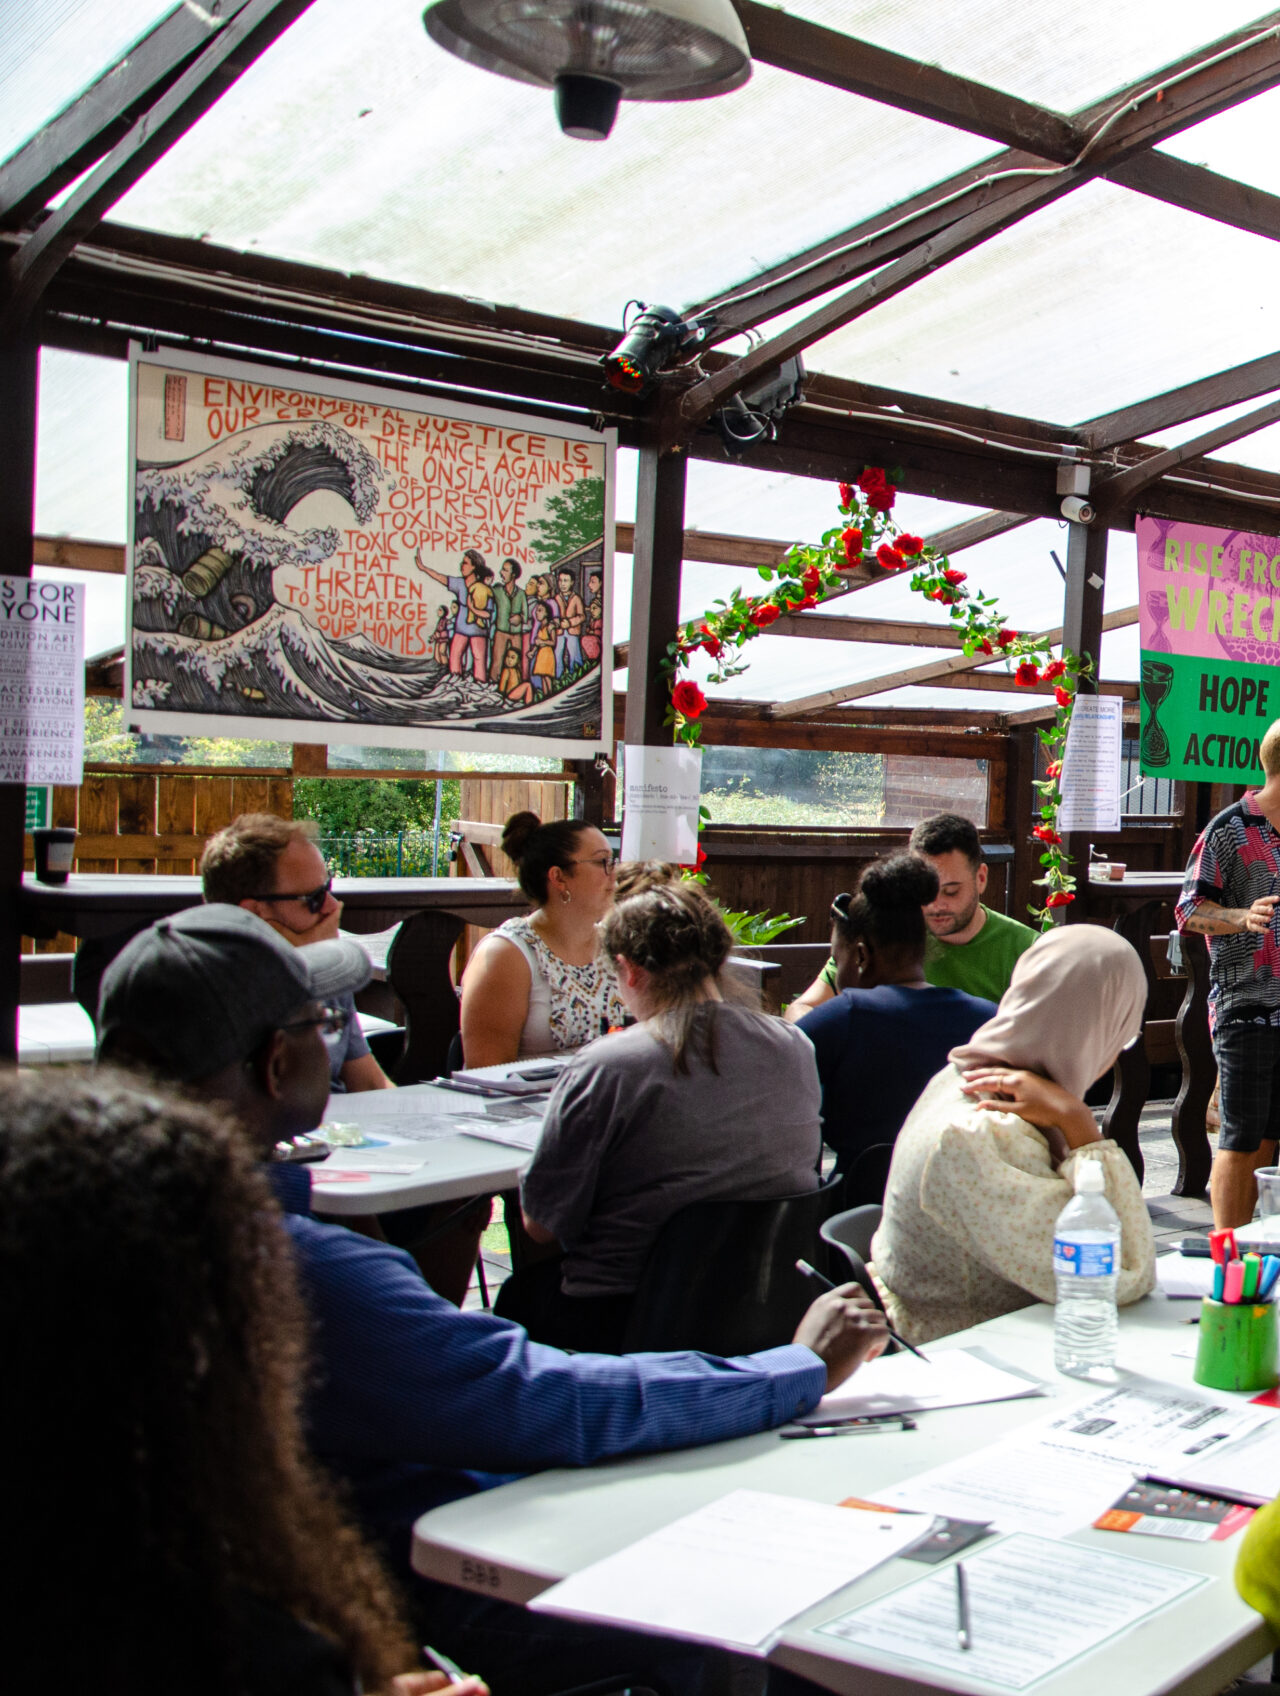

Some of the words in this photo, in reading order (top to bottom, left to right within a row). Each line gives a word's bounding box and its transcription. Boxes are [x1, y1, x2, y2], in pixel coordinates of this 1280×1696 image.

[204, 377, 404, 423] ENVIRONMENTAL
[418, 416, 546, 457] JUSTICE
[564, 440, 590, 463] IS
[207, 406, 260, 439] OUR
[277, 407, 339, 419] CRY
[344, 413, 369, 429] OF
[383, 419, 486, 470] DEFIANCE
[494, 452, 593, 484] AGAINST
[370, 435, 409, 475] THE
[423, 456, 543, 502] ONSLAUGHT
[400, 476, 418, 489] OF
[389, 486, 527, 528] OPPRESIVE
[378, 509, 468, 533] TOXINS
[477, 521, 521, 542] AND
[337, 552, 399, 572] THAT
[344, 529, 399, 555] TOXIC
[402, 530, 535, 564] OPPRESSIONS
[1164, 538, 1224, 578] RISE
[27, 582, 75, 603] FOR
[300, 565, 423, 600] THREATEN
[2, 600, 75, 623] YONE
[285, 584, 309, 606] TO
[315, 594, 428, 622] SUBMERGE
[317, 614, 357, 638] OUR
[363, 621, 433, 655] HOMES.
[1, 685, 75, 697] ACCESSIBLE
[19, 696, 75, 706] EVERYONE
[1199, 673, 1270, 717] HOPE
[4, 728, 75, 738] EXPERIENCE
[0, 748, 74, 758] AWARENESS
[1183, 733, 1264, 771] ACTION
[32, 772, 73, 781] FORMS
